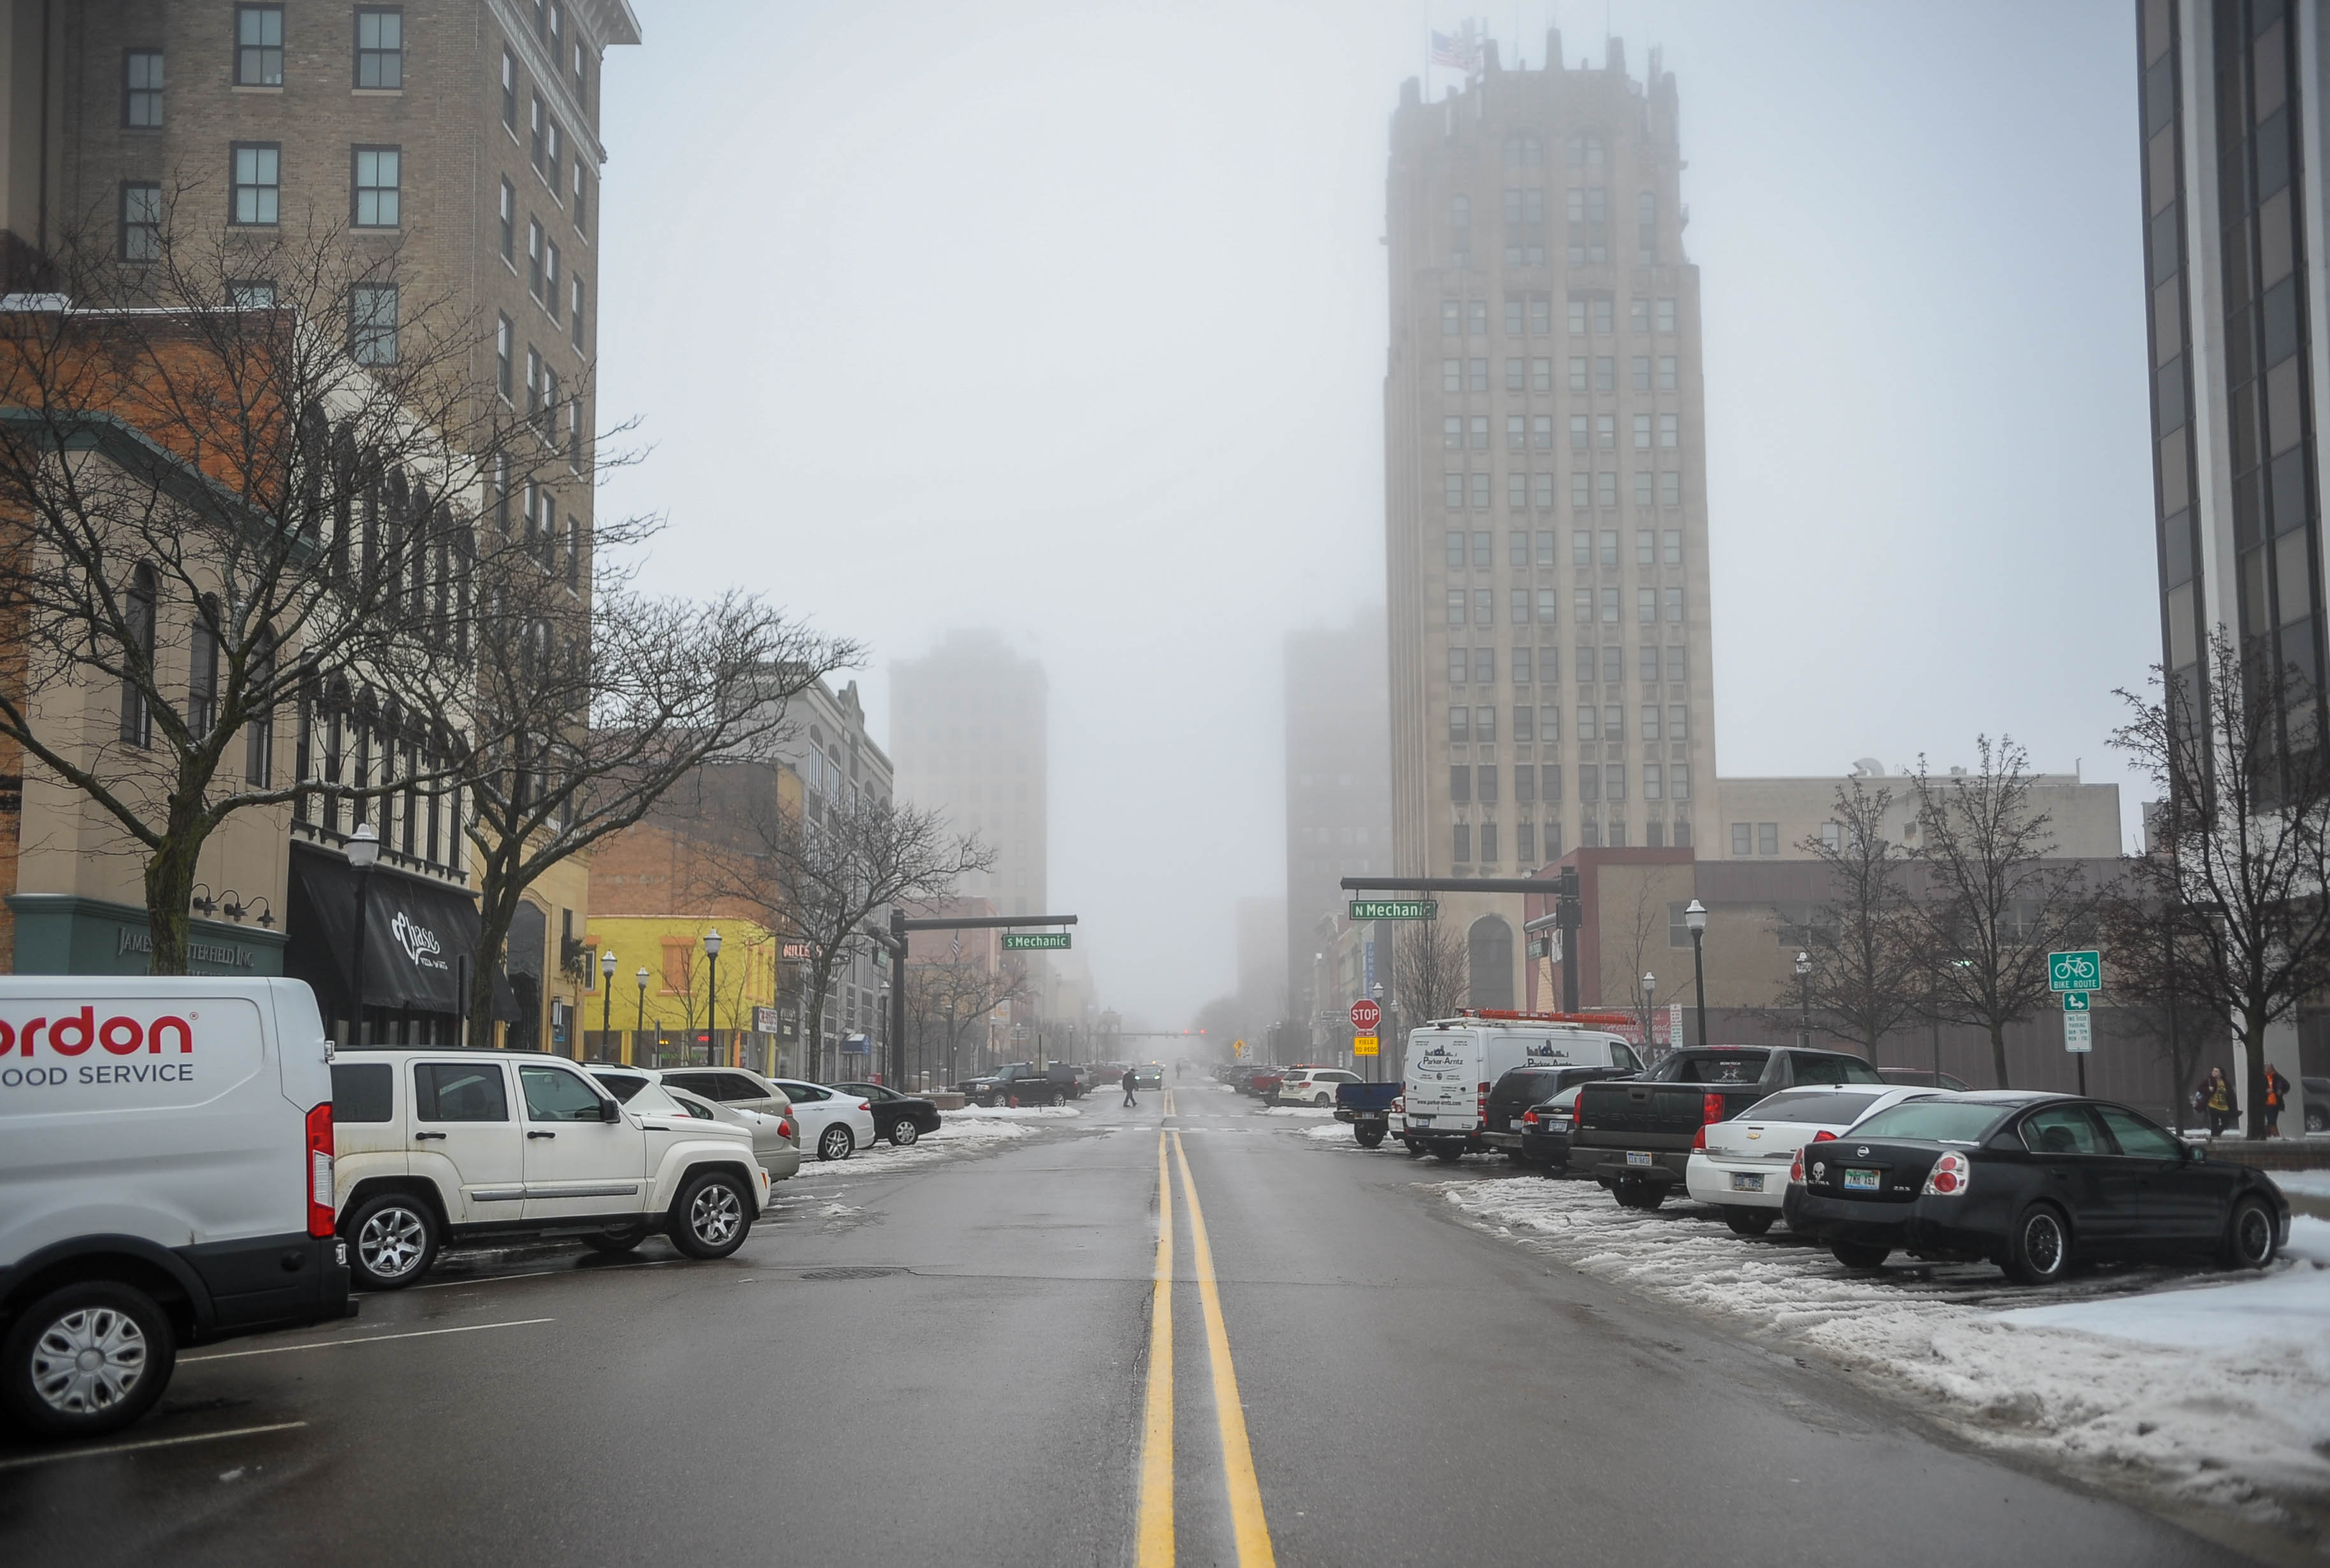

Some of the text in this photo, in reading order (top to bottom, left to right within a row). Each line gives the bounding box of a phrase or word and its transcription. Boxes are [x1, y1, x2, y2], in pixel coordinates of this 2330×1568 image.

[1355, 902, 1430, 916] N Mechanic
[391, 911, 441, 965] Chase
[1007, 935, 1066, 947] S Mechanic
[187, 942, 234, 964] TTERFIELD
[2073, 979, 2097, 988] ROUTE
[1352, 1009, 1378, 1021] STOP
[2, 1063, 194, 1087] OOD SERVICE
